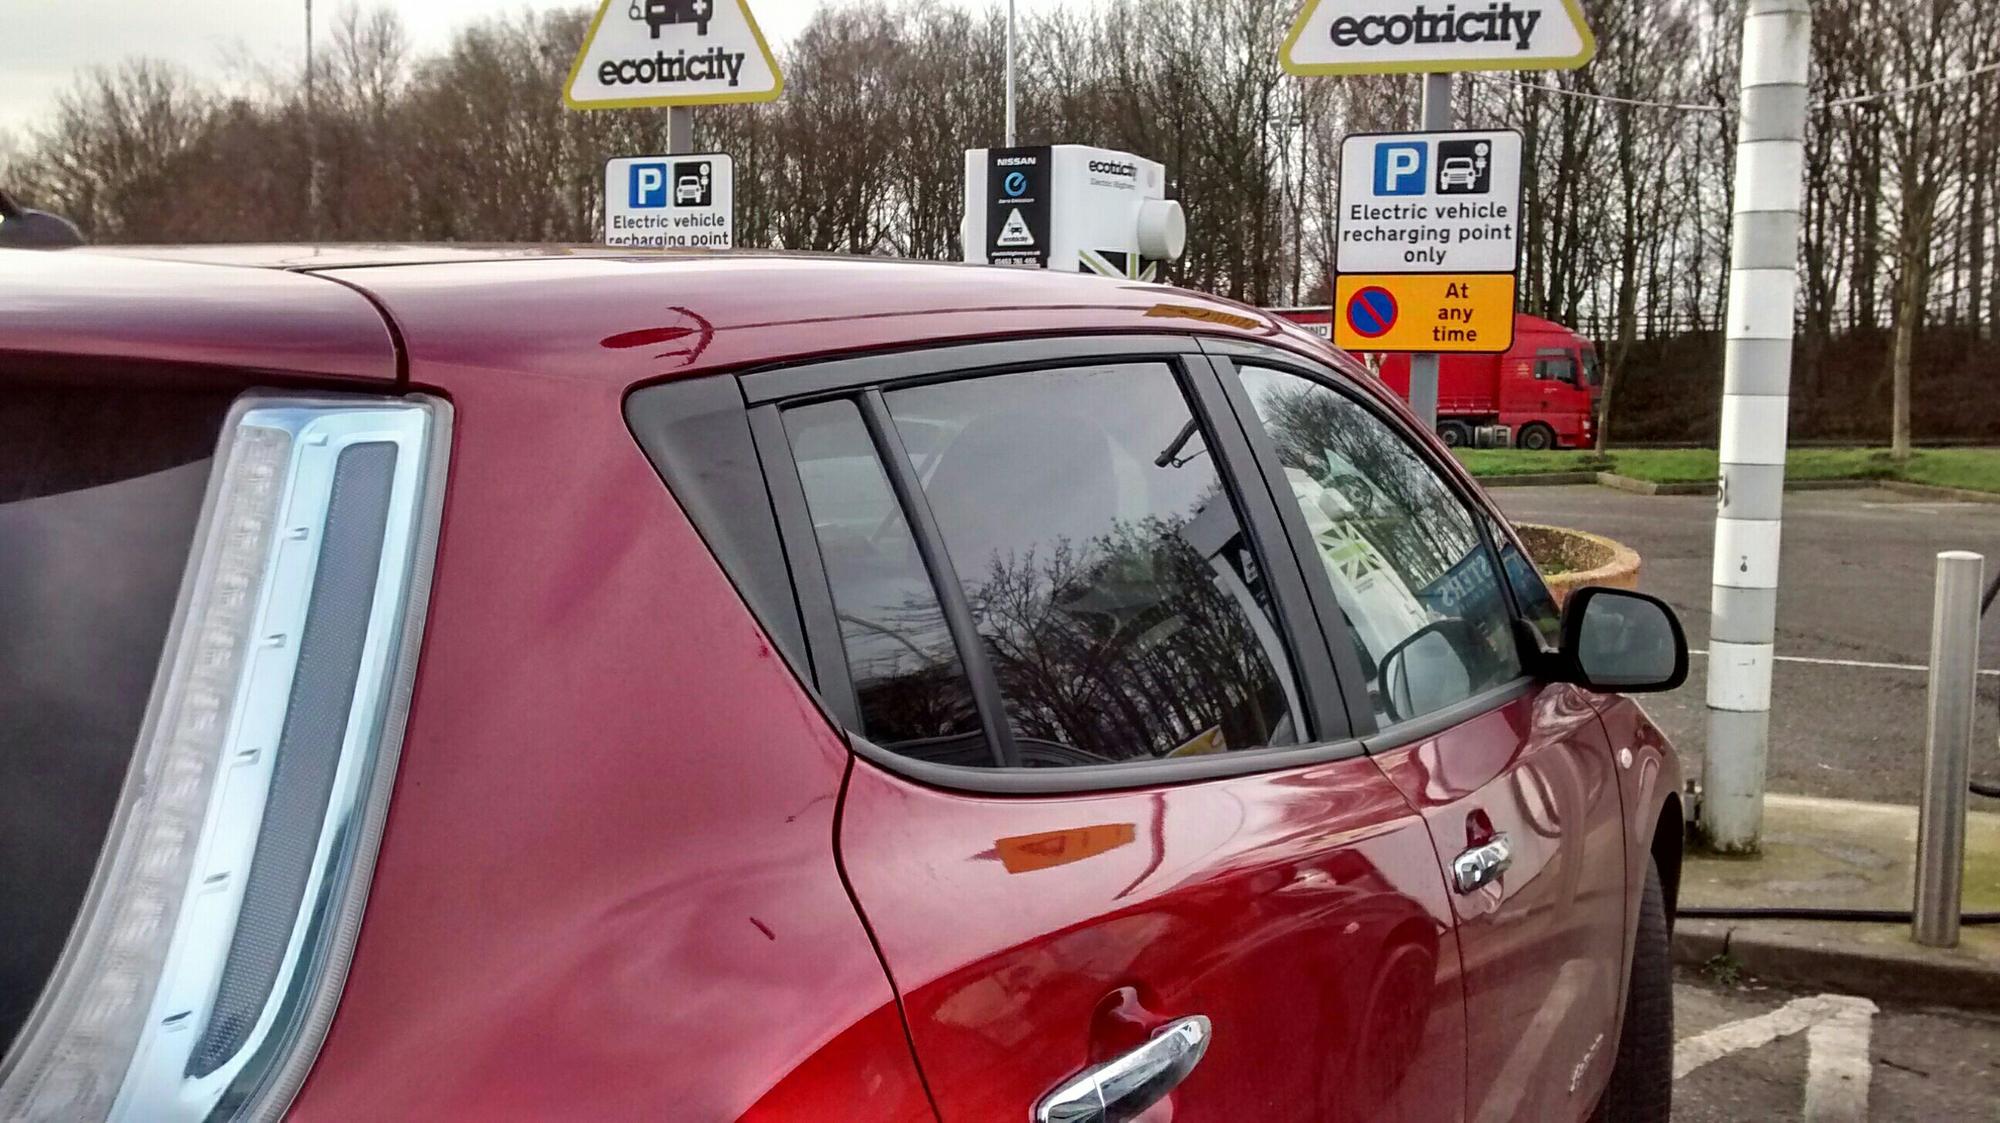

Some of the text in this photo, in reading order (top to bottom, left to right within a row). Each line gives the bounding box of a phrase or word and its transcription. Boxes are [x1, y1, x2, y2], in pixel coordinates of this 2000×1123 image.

[1330, 3, 1541, 50] ecotricity
[598, 47, 745, 86] ecotricity
[997, 157, 1036, 166] NISSAN
[1386, 147, 1420, 191] P
[638, 168, 662, 204] P
[613, 213, 725, 229] Electric vehicle
[1350, 202, 1508, 221] Electric vehicle
[609, 232, 729, 246] recharging point
[1343, 224, 1512, 244] recharging point
[1404, 246, 1447, 265] only
[1445, 283, 1469, 299] At
[1438, 304, 1474, 323] any
[1433, 325, 1477, 342] time
